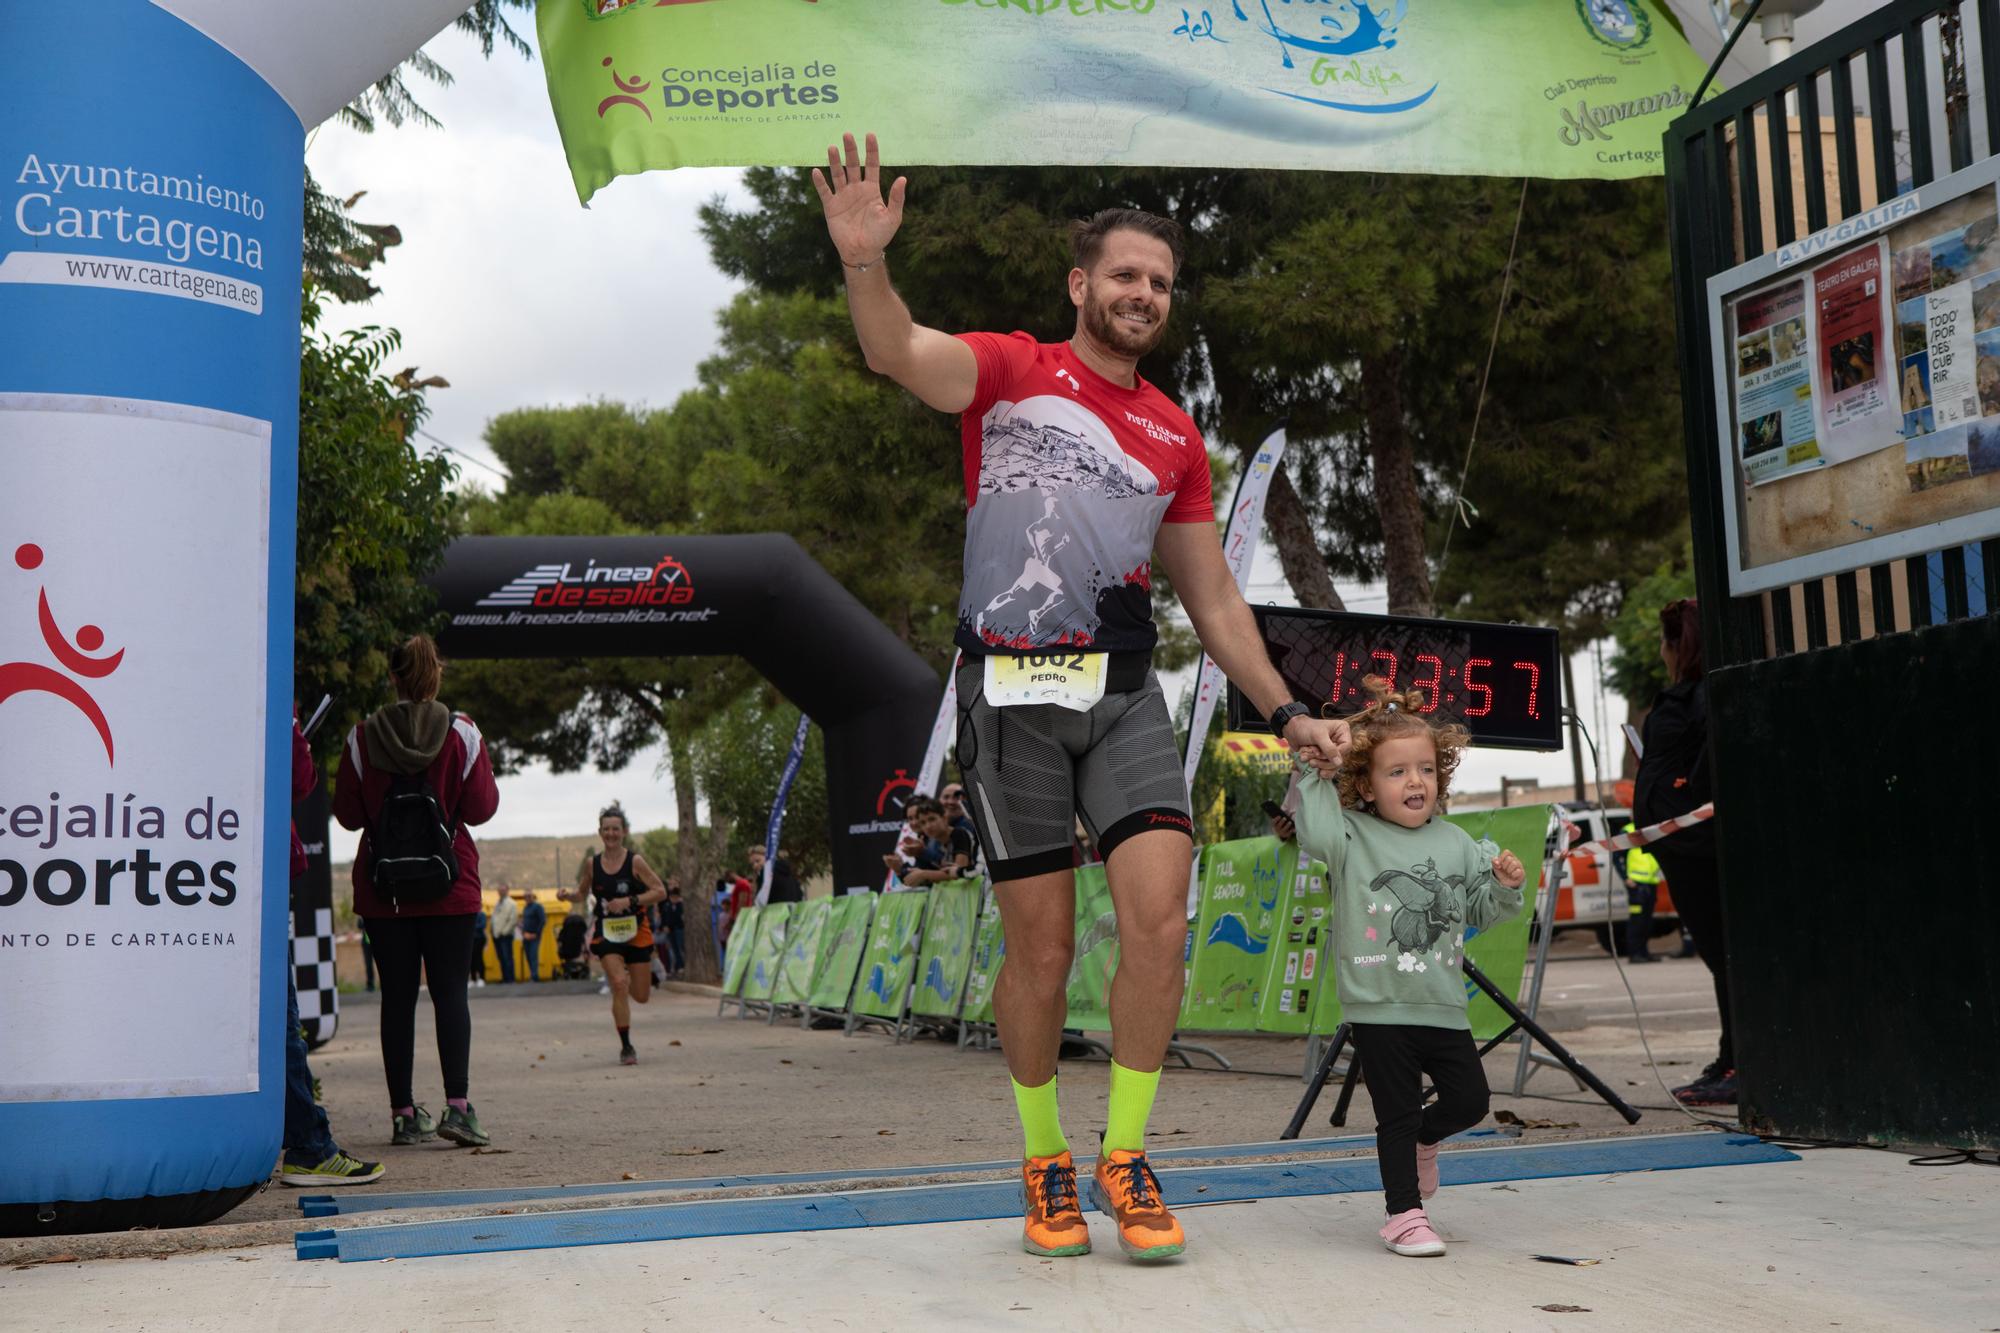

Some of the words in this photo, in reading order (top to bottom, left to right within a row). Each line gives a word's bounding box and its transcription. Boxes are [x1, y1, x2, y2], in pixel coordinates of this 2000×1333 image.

[1172, 8, 1229, 43] del
[661, 62, 796, 87] Concejalía
[803, 60, 837, 79] de
[663, 82, 840, 112] Deportes
[668, 115, 752, 123] AYUNTAMIENTO
[777, 113, 841, 122] CARTAGENA
[1596, 150, 1663, 163] Cartage
[16, 153, 265, 220] Ayuntamiento
[15, 192, 264, 270] Cartagena
[65, 260, 258, 306] www.cartagena.es
[1125, 411, 1155, 430] VISTA
[452, 607, 719, 626] www.lineadesalida.net
[1031, 673, 1067, 683] PEDRO
[0, 791, 165, 849] ejalía
[185, 796, 240, 841] de
[66, 933, 97, 946] DE
[111, 932, 236, 946] CARTAGENA
[1353, 954, 1387, 964] DUMBO
